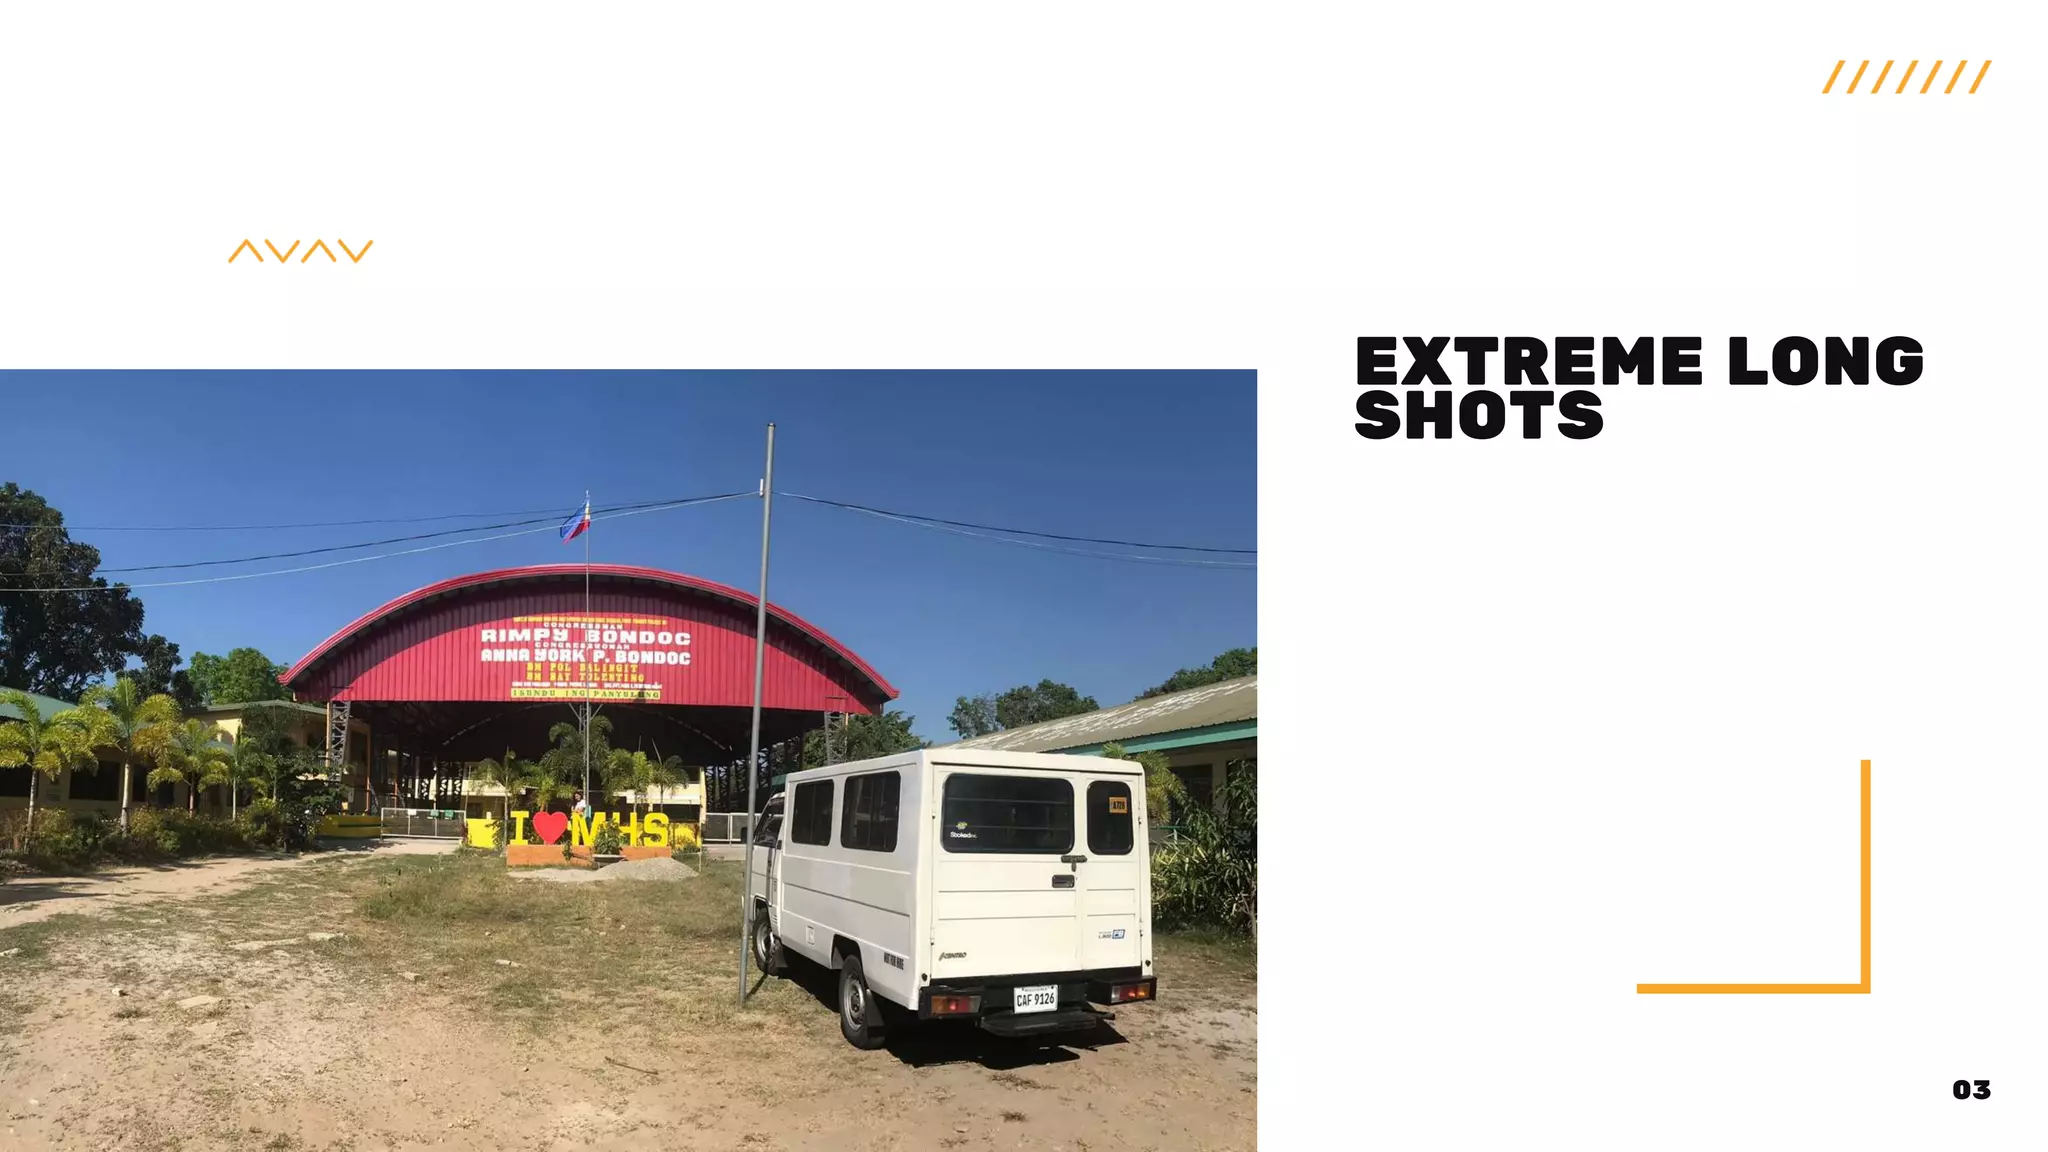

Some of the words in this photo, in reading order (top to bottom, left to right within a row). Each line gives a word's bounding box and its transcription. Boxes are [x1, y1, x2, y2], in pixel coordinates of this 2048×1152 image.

[543, 622, 623, 630] CONGRESSMAN
[481, 628, 568, 642] RIMPY
[585, 630, 691, 645] BONDOC
[481, 648, 530, 662] ANNA
[534, 648, 586, 662] YORK
[593, 650, 610, 663] P.
[615, 650, 691, 665] BONDOC
[549, 662, 571, 671] POL
[513, 689, 556, 697] ISUNDU
[565, 690, 586, 698] ING
[510, 811, 530, 845] I
[570, 811, 669, 847] MHS
[1017, 994, 1032, 1007] CAF
[1034, 992, 1055, 1005] 9126
